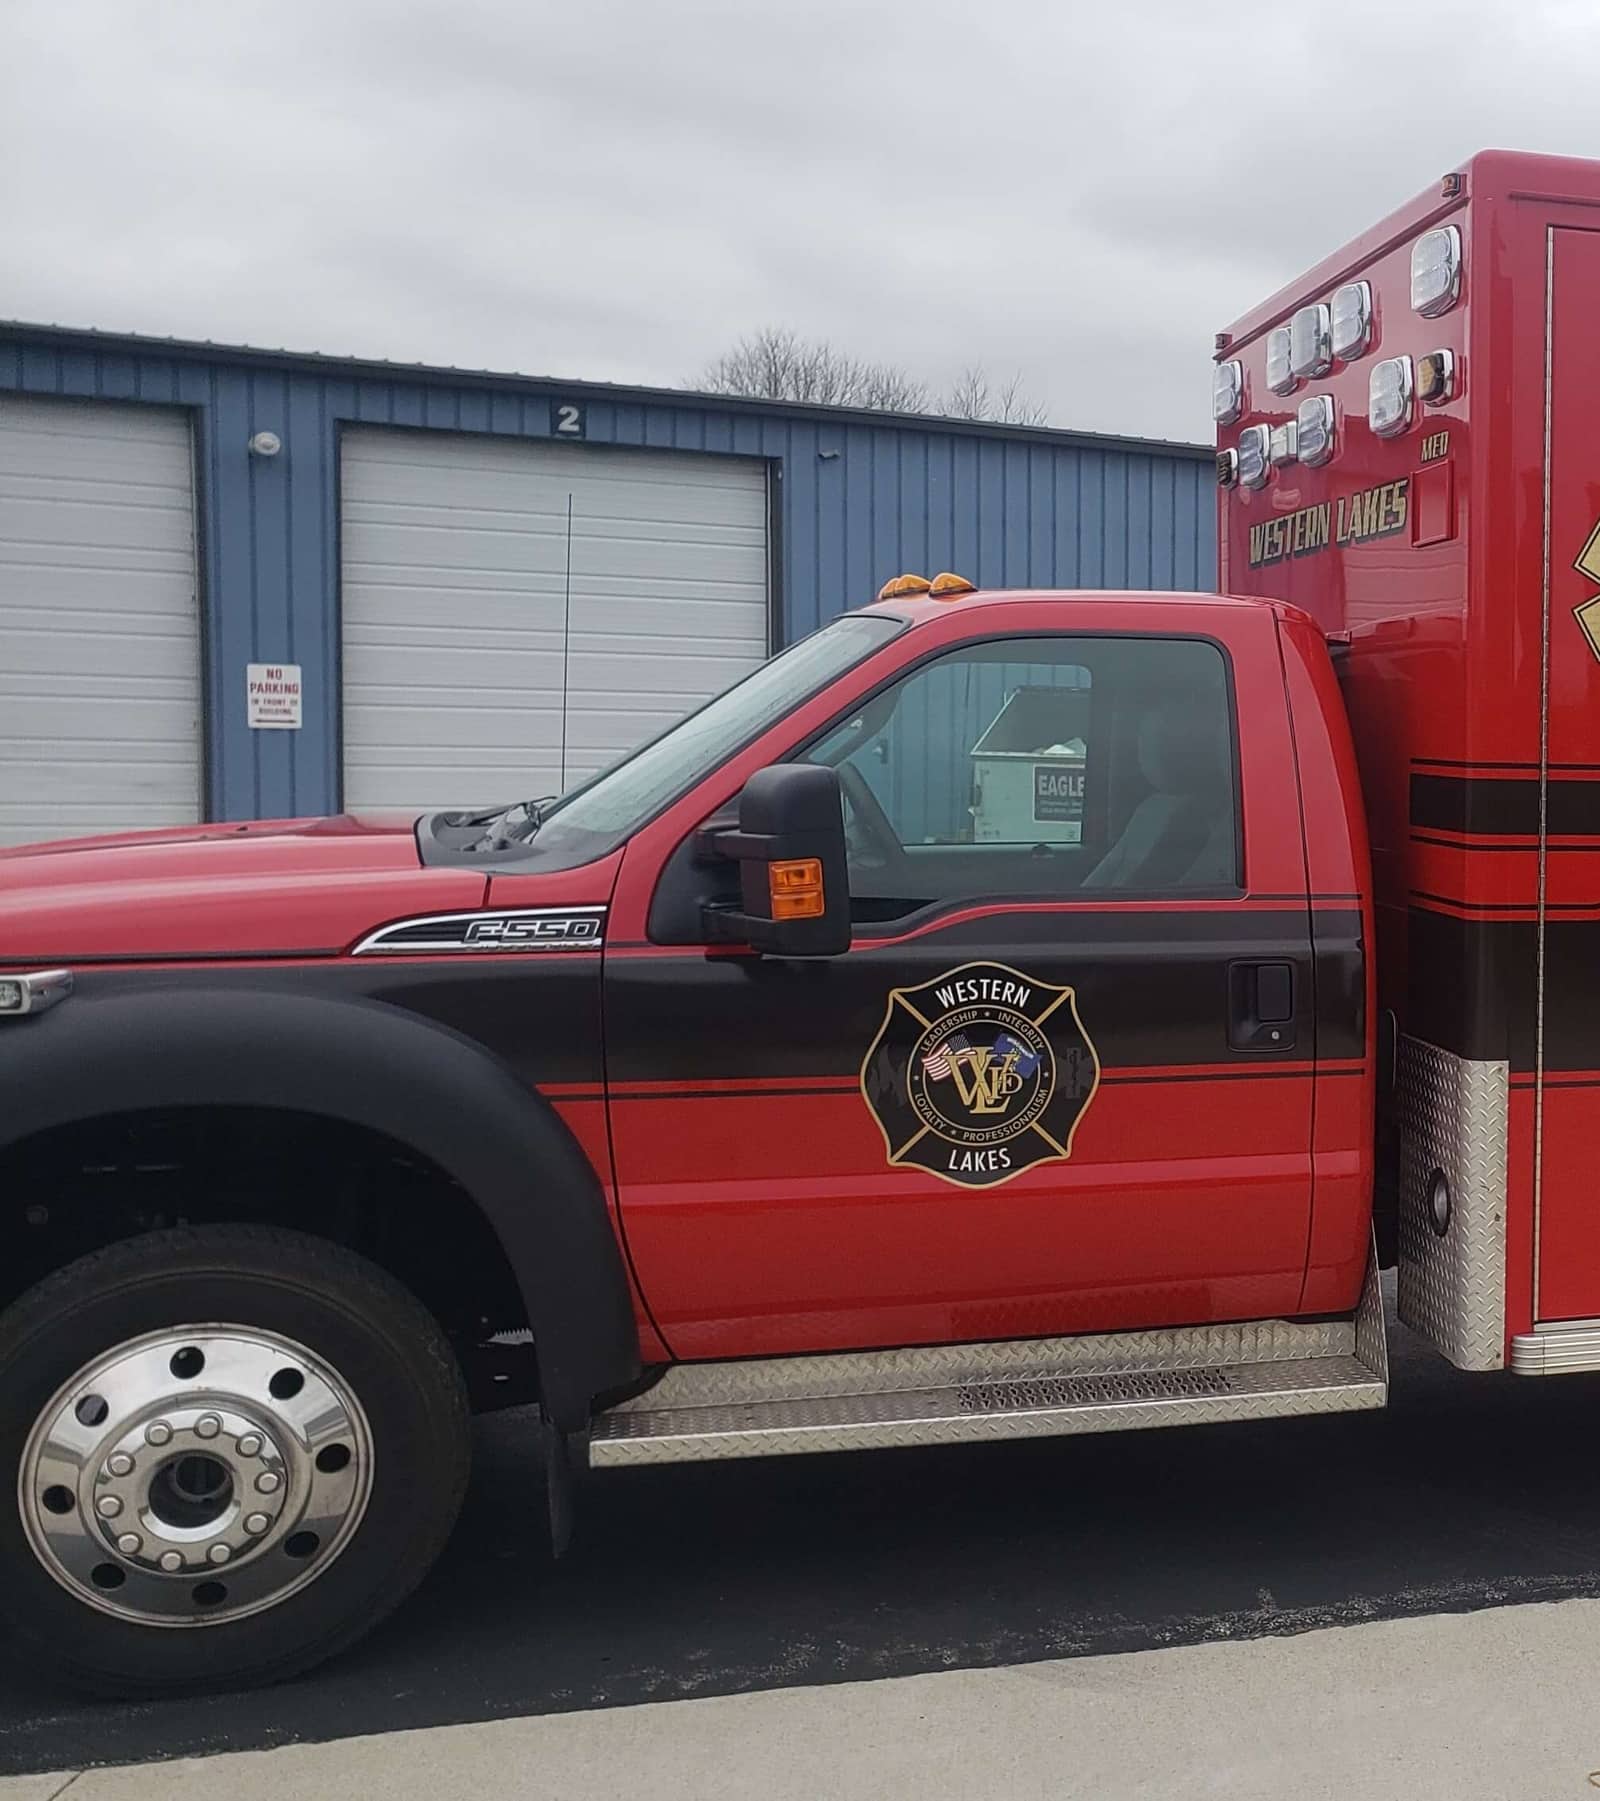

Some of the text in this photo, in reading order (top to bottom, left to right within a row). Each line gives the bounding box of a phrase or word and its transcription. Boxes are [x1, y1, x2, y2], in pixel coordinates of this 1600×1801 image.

[558, 406, 579, 431] 2
[1420, 431, 1449, 463] MED
[1249, 477, 1409, 568] WESTERN LAKES
[266, 668, 283, 680] NO
[250, 682, 299, 694] PARKING
[1039, 775, 1085, 797] EAGLE
[464, 918, 601, 944] F-550
[935, 979, 1032, 1009] WESTERN
[920, 1010, 979, 1051] LEADERSHIP
[997, 1011, 1045, 1050] INTEGRITY
[914, 1088, 1049, 1142] LOYALTY PROFESSIONALISM
[948, 1148, 1011, 1172] LAKES
